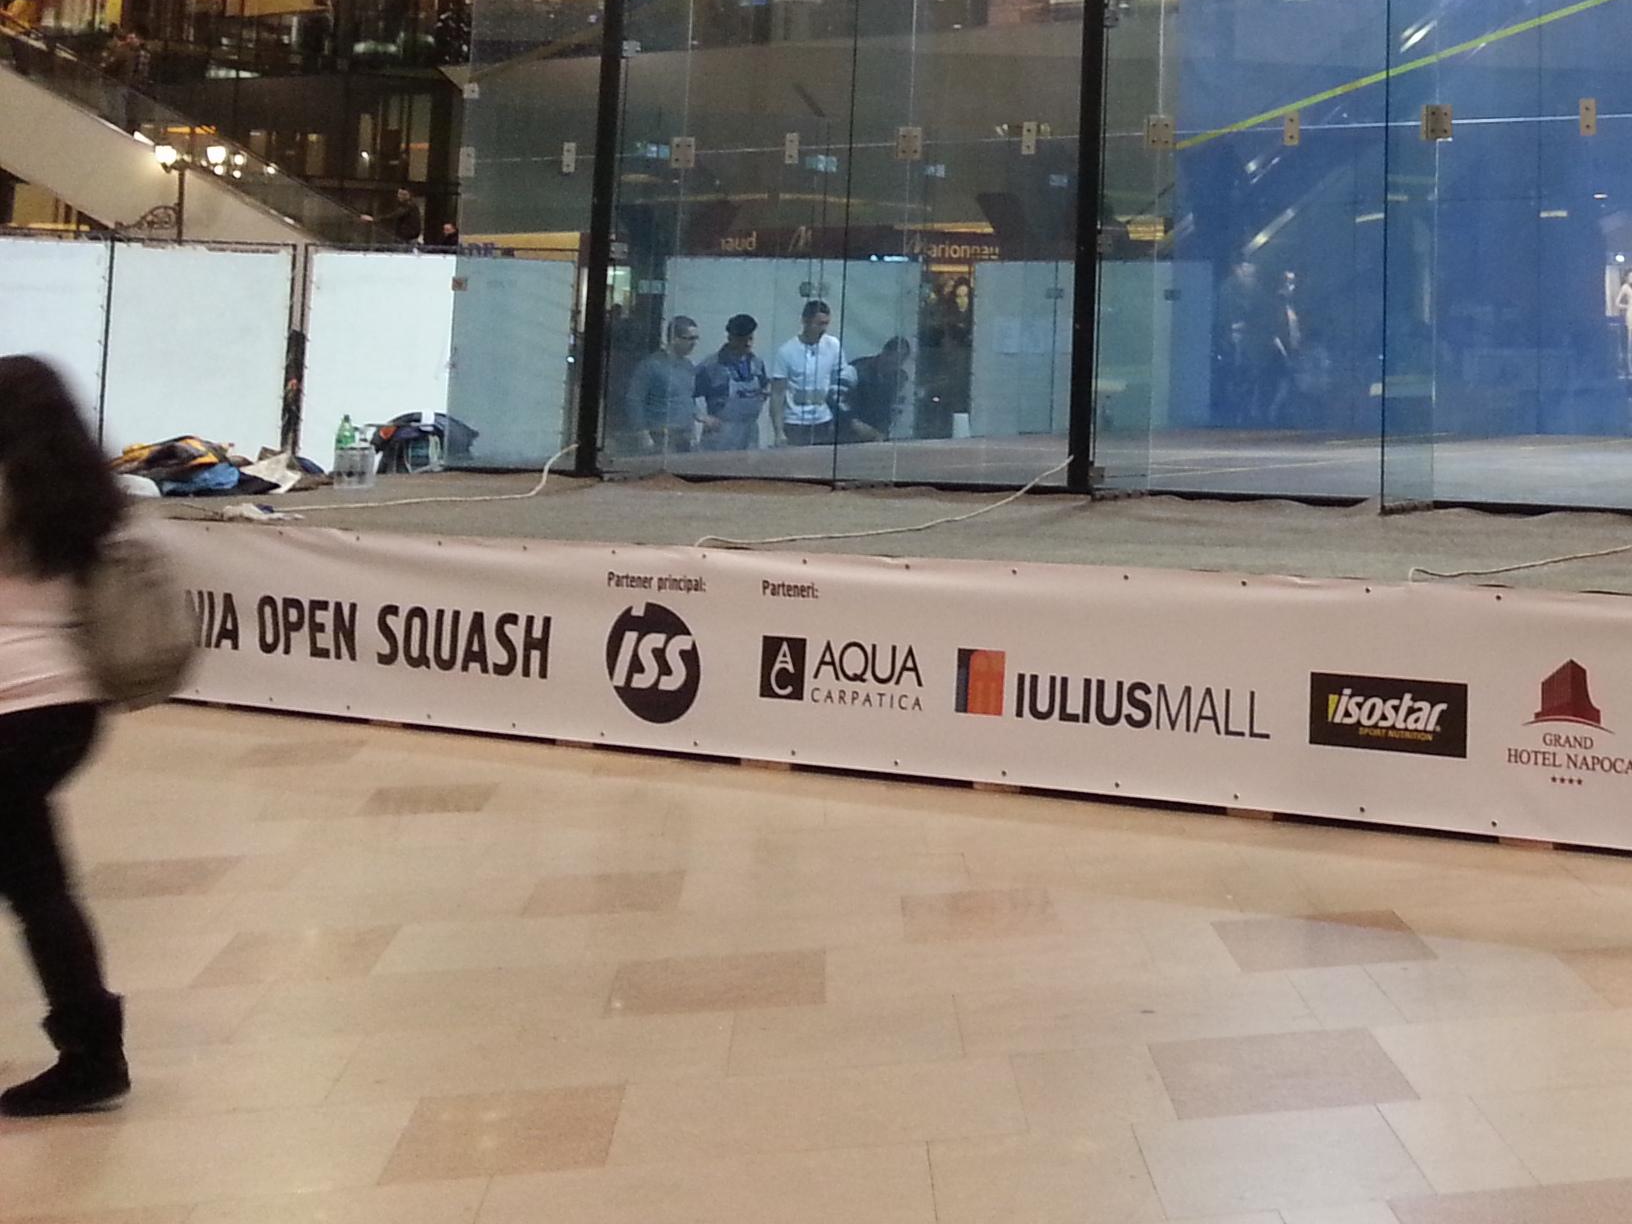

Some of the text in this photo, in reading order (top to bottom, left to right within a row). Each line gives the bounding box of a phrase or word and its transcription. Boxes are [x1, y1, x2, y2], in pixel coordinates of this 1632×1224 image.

[607, 571, 707, 593] Partener principal:
[761, 580, 820, 599] Parteneri:
[257, 594, 358, 662] OPEN
[376, 603, 553, 680] SQUASH
[612, 630, 694, 691] ISS
[813, 639, 923, 687] AQUA
[810, 686, 923, 712] CARPATICA
[1333, 687, 1448, 732] isostar
[1358, 727, 1434, 742] SPORT NUTRITION
[1542, 732, 1594, 750] GRAND
[1507, 747, 1563, 768] HOTEL
